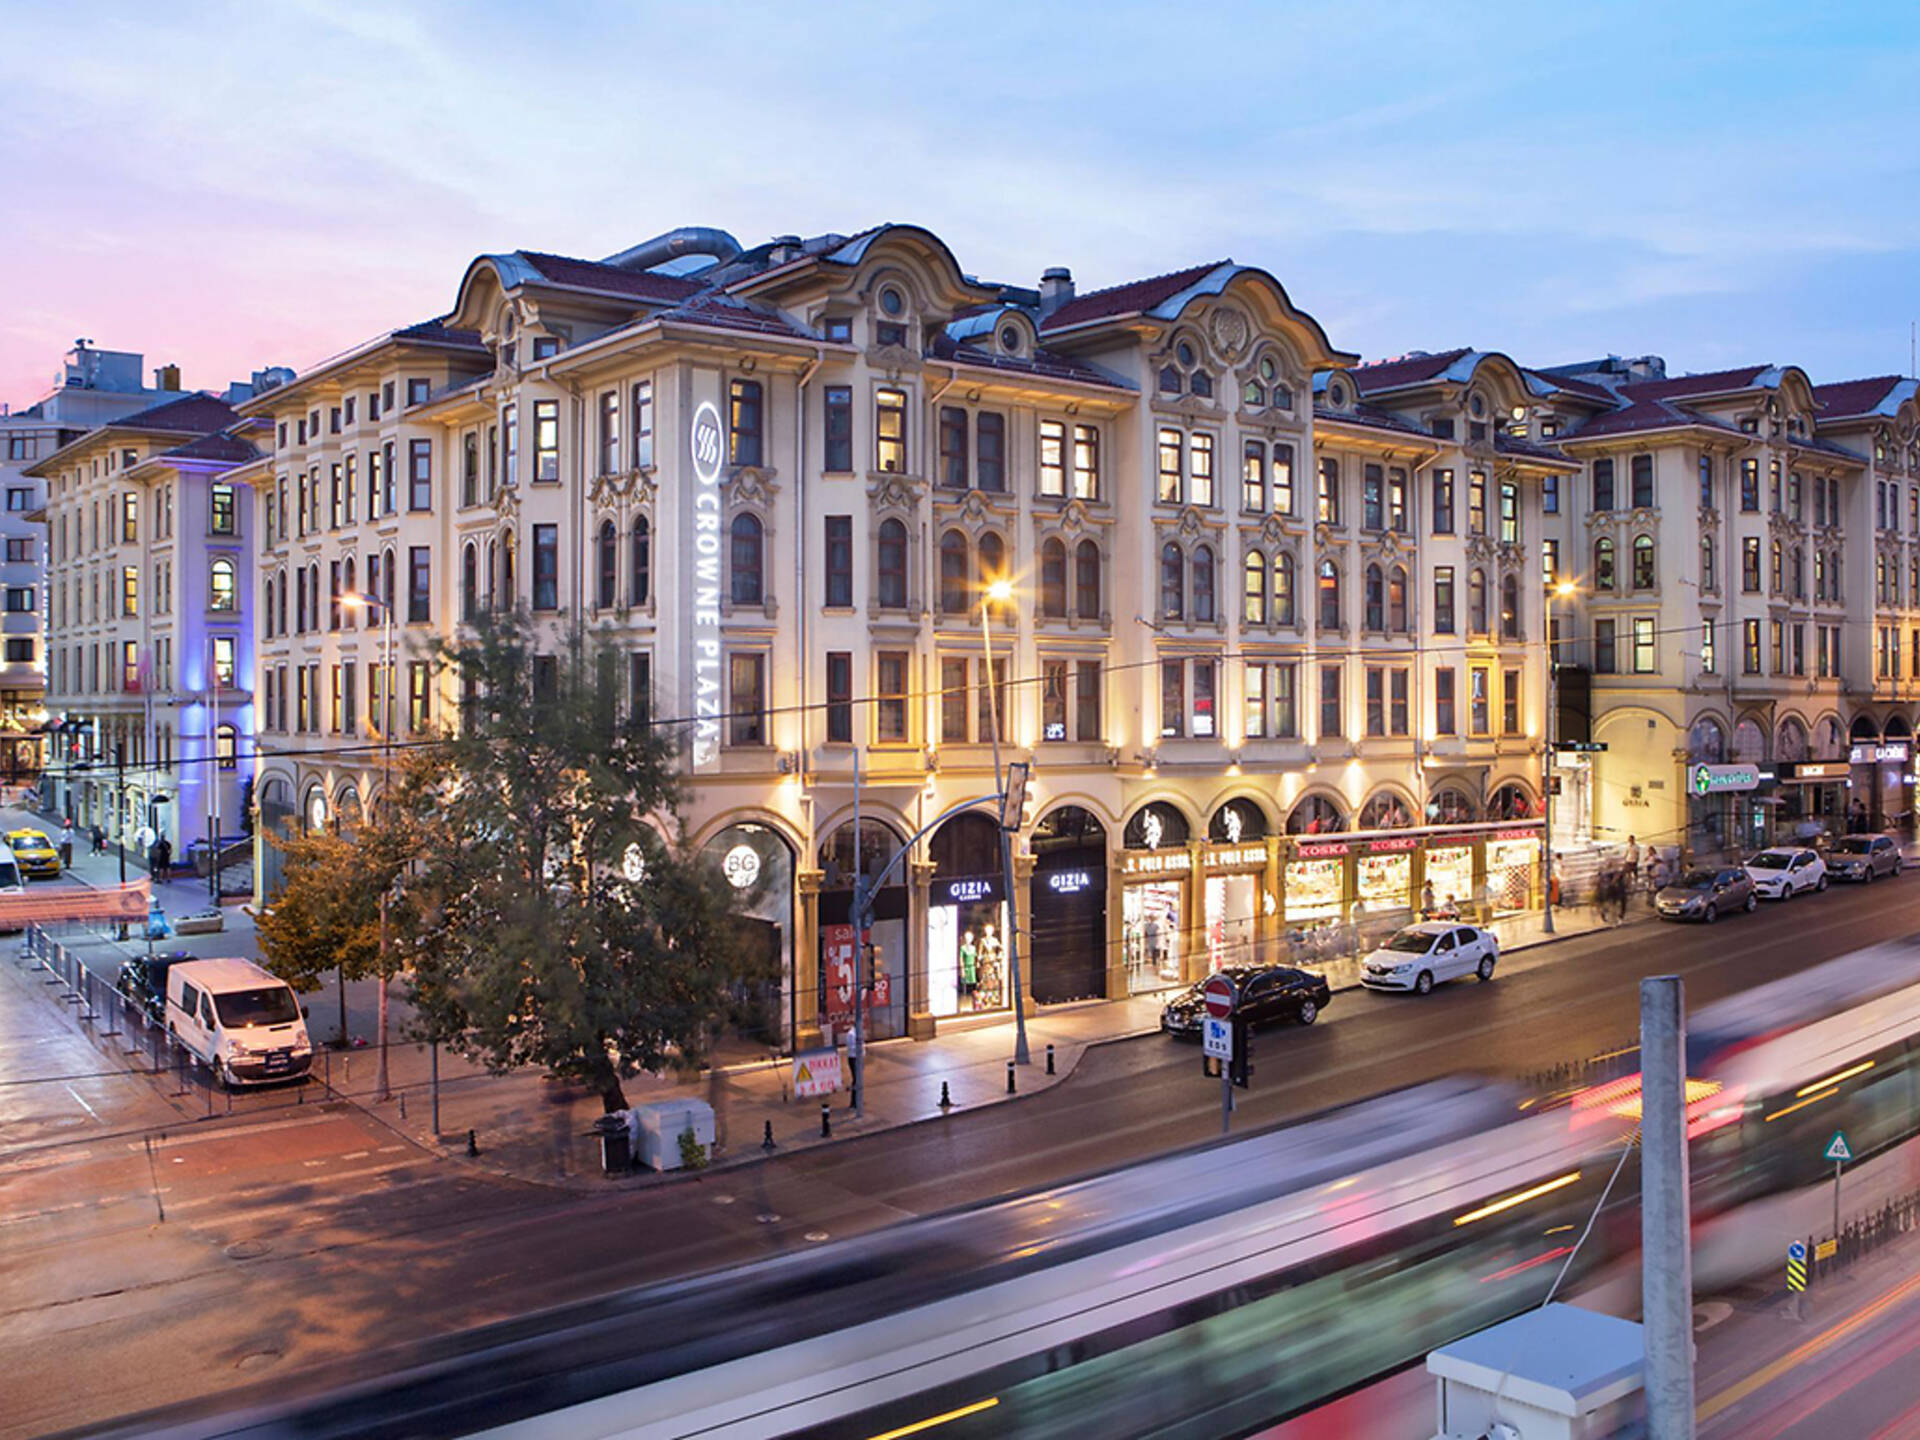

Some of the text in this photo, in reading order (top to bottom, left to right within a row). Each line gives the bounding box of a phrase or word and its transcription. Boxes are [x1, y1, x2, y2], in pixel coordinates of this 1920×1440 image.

[696, 493, 719, 738] CROWNE PLAZA
[1298, 844, 1349, 857] KOSKA
[1370, 839, 1417, 851] KOSKA
[728, 853, 756, 872] BG
[1050, 872, 1090, 888] GIZIA
[950, 881, 992, 897] GIZIA
